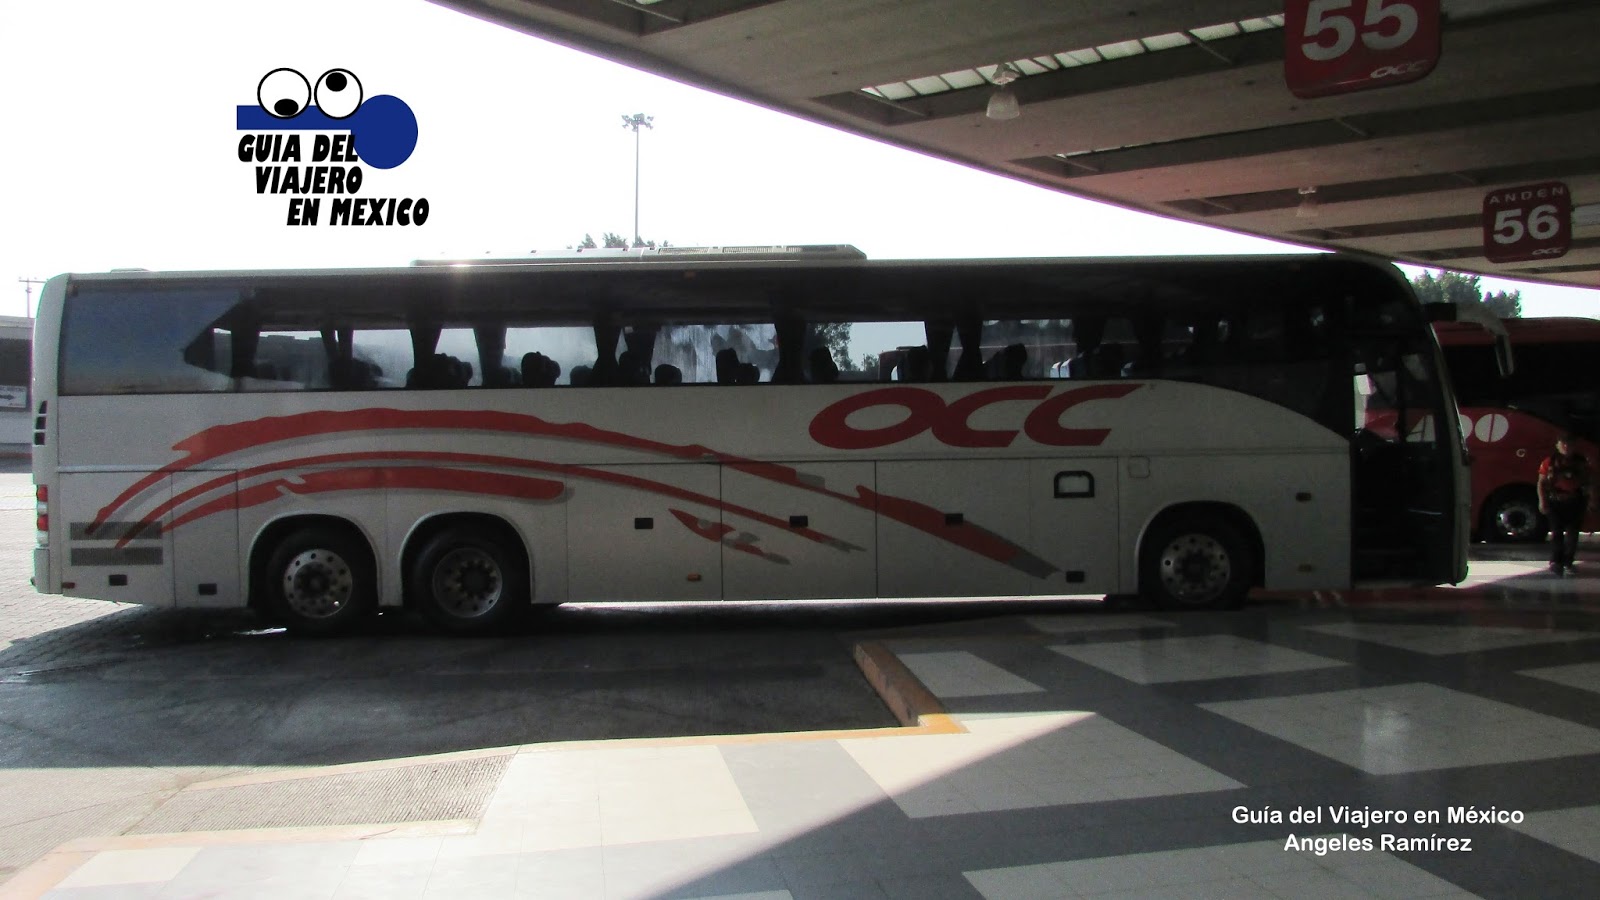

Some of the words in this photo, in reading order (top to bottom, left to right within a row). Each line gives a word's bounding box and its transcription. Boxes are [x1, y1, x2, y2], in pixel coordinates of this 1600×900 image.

[1301, 0, 1419, 61] 55
[1489, 186, 1565, 205] ANDEN
[1492, 204, 1560, 244] 56
[808, 383, 1146, 450] OCC
